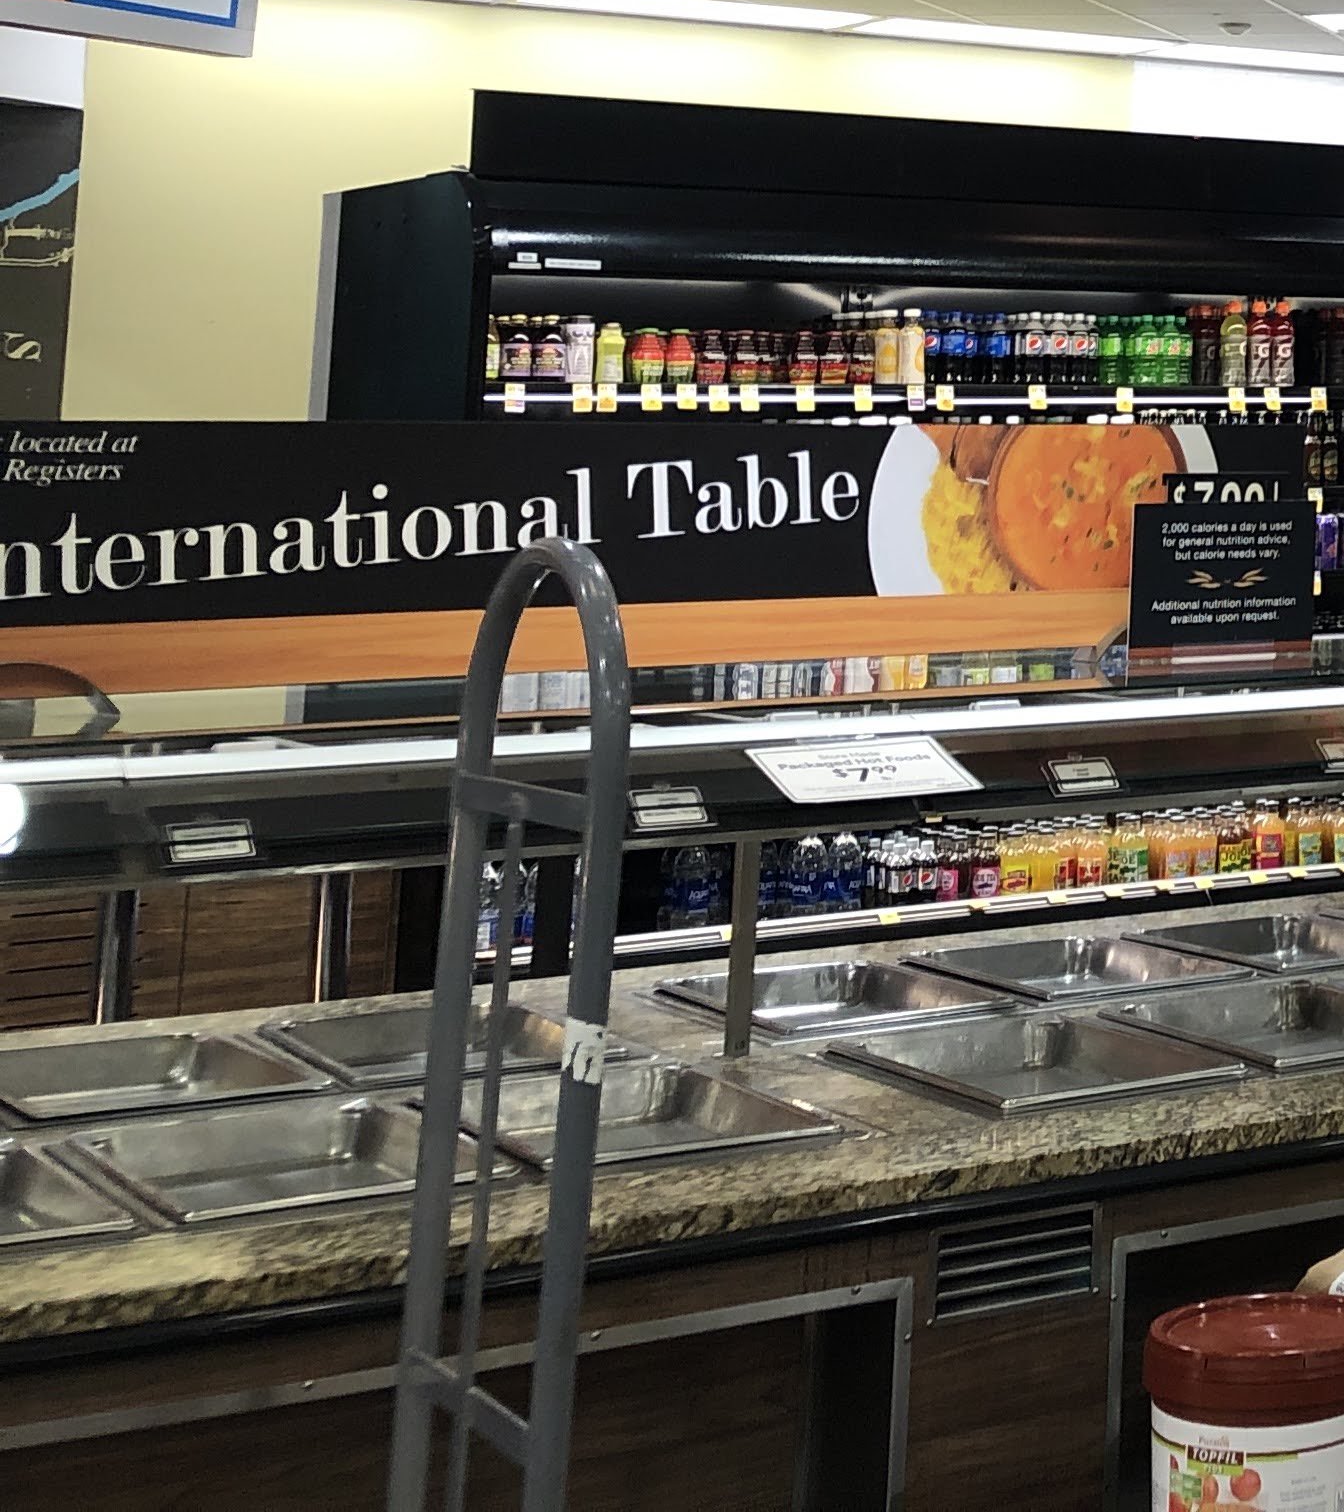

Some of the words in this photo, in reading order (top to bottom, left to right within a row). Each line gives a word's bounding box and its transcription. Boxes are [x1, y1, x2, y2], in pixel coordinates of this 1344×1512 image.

[8, 430, 108, 454] located
[111, 435, 139, 454] at
[2, 458, 124, 487] Registers
[626, 449, 861, 540] Table
[1162, 522, 1189, 534] 2,000
[1191, 521, 1229, 533] calories
[1239, 521, 1257, 534] day
[1259, 521, 1267, 531] is
[1269, 520, 1293, 531] used
[1162, 537, 1176, 548] for
[1178, 537, 1214, 549] general
[1216, 535, 1255, 546] nutrition
[1175, 550, 1191, 561] but
[1193, 549, 1225, 560] calorie
[1228, 548, 1256, 559] needs
[1259, 549, 1280, 560] vary.
[1151, 600, 1200, 611] Additional
[1203, 599, 1241, 610] nutrition
[1244, 596, 1296, 608] information
[1171, 613, 1213, 625] available
[1215, 613, 1239, 624] upon
[1242, 611, 1280, 623] request.
[778, 758, 853, 770] Packaged
[855, 756, 884, 766] Hot
[886, 753, 931, 763] Foods
